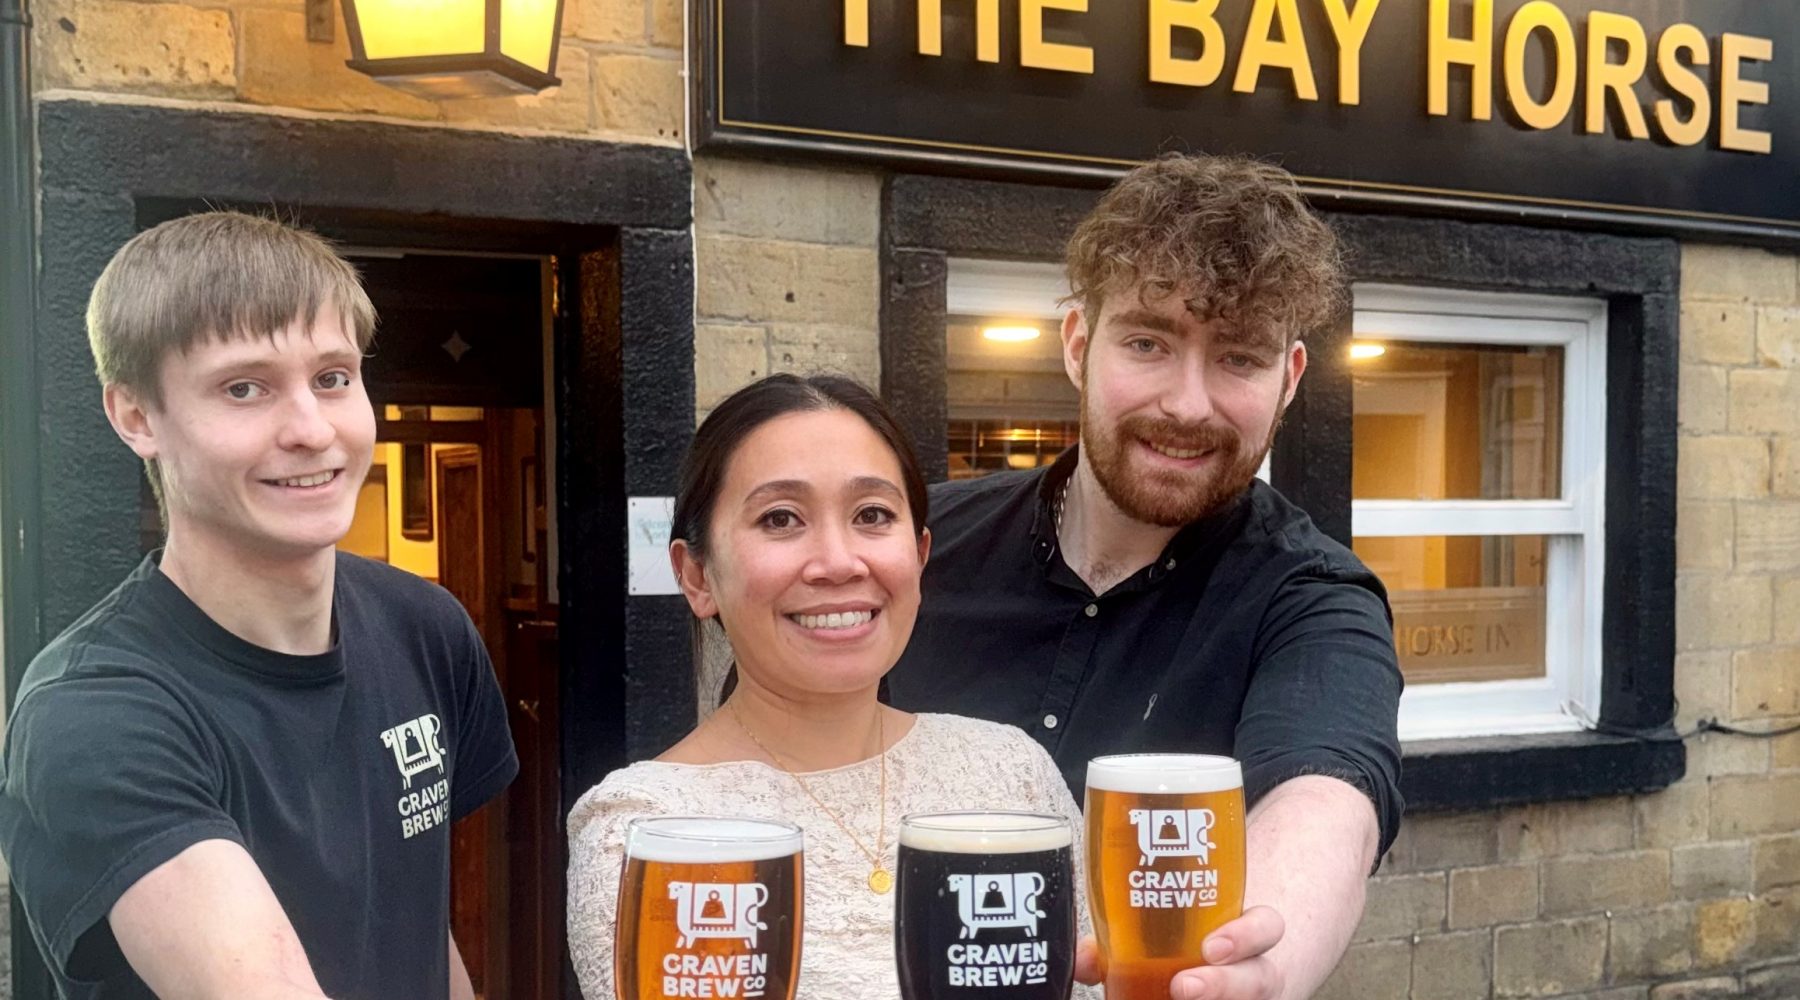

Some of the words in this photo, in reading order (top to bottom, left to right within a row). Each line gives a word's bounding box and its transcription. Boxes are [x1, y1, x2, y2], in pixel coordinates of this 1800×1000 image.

[1149, 0, 1381, 106] BAY
[1428, 0, 1773, 155] HORSE
[1396, 624, 1474, 657] HORSE
[401, 803, 444, 840] BREW
[1128, 869, 1218, 889] CRAVEN
[1130, 889, 1197, 909] BREW
[1199, 888, 1218, 901] CO
[662, 953, 768, 976] CRAVEN
[947, 941, 1048, 965] CRAVEN
[663, 975, 740, 998] BREW
[743, 976, 766, 990] CO
[948, 965, 1024, 987] BREW
[1026, 962, 1048, 978] CO
